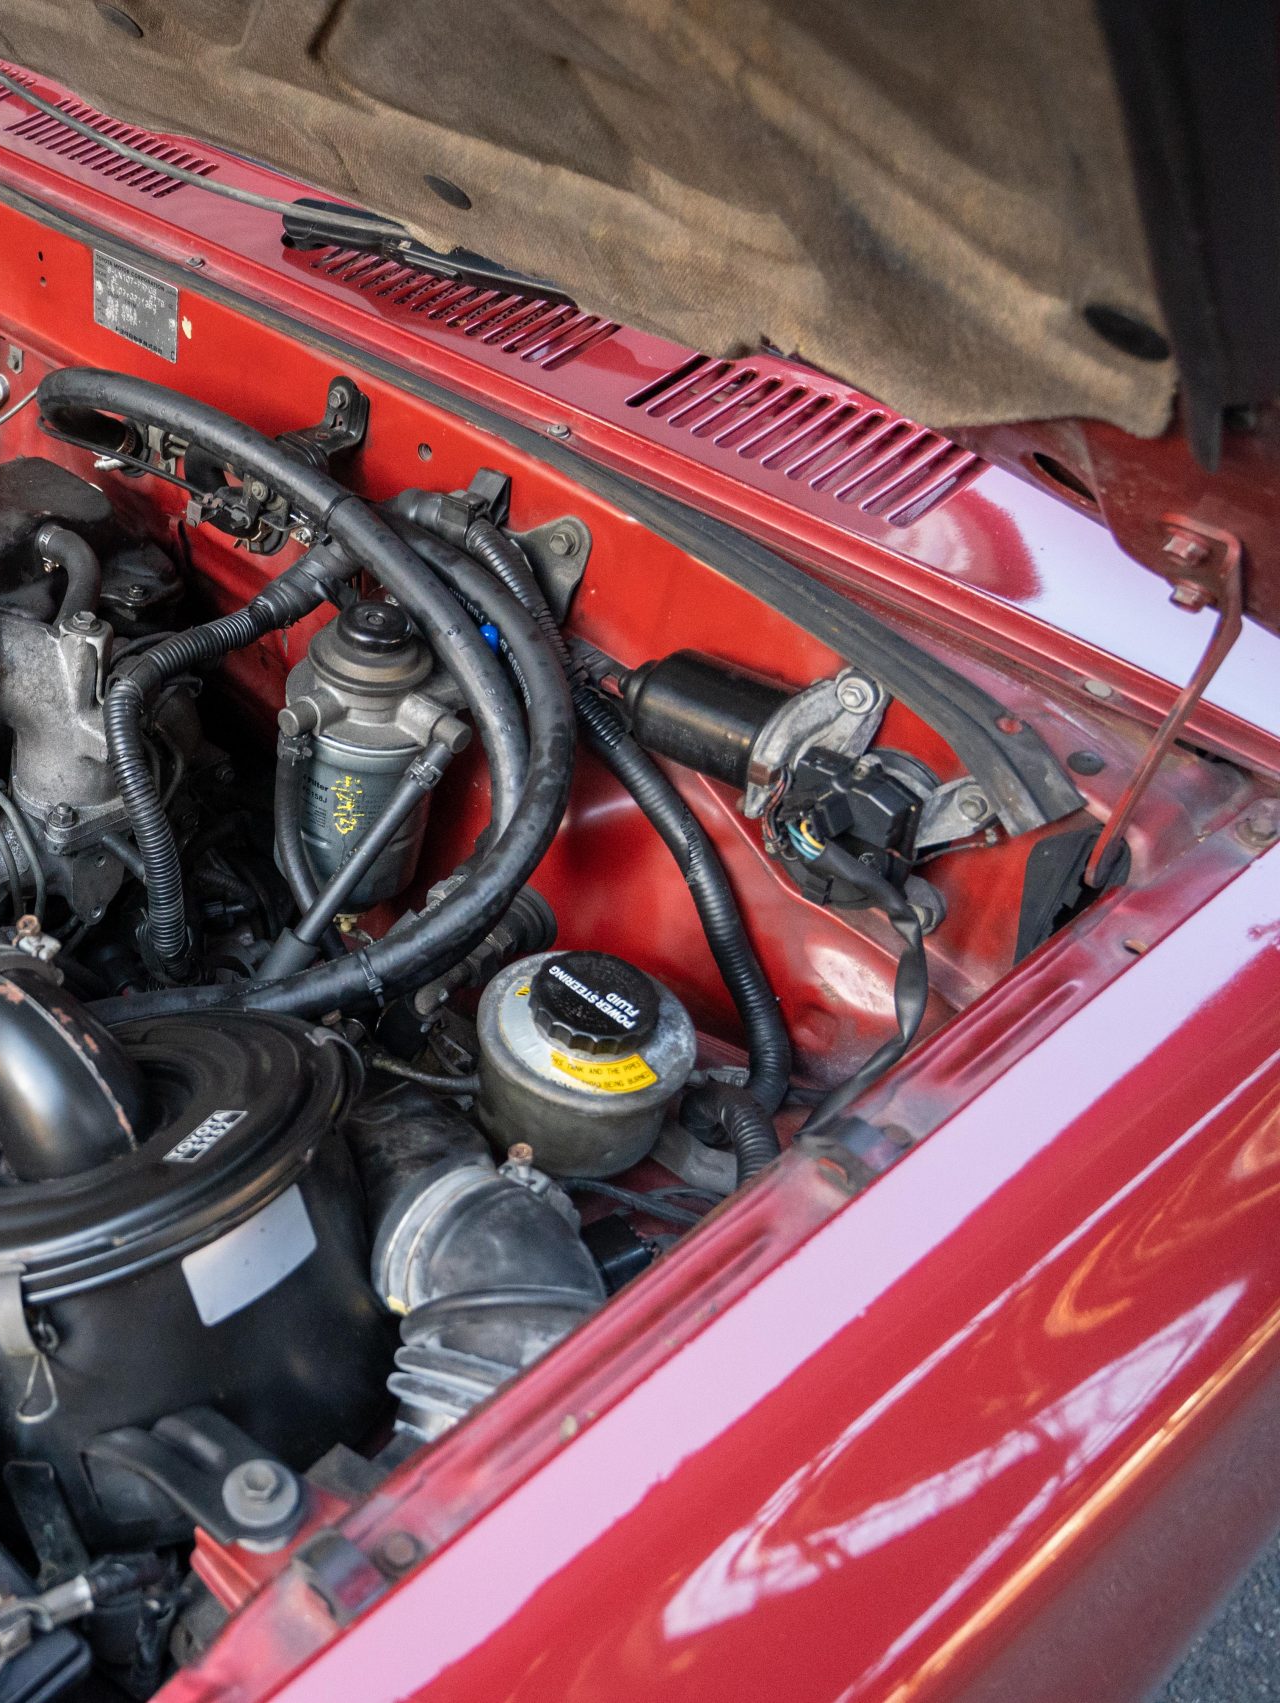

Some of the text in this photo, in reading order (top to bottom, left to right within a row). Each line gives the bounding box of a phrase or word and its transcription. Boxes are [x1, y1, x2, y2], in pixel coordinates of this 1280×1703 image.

[95, 254, 113, 266] TOYOTA
[113, 262, 130, 275] MOTOR
[131, 271, 165, 291] CORPORATION
[467, 603, 485, 623] Fuel
[548, 965, 602, 1004] STEERING
[595, 1000, 638, 1030] POWER
[606, 993, 641, 1017] FLUID
[589, 1067, 602, 1075] AND
[604, 1079, 624, 1088] BEING
[165, 1112, 232, 1160] TOYOTA
